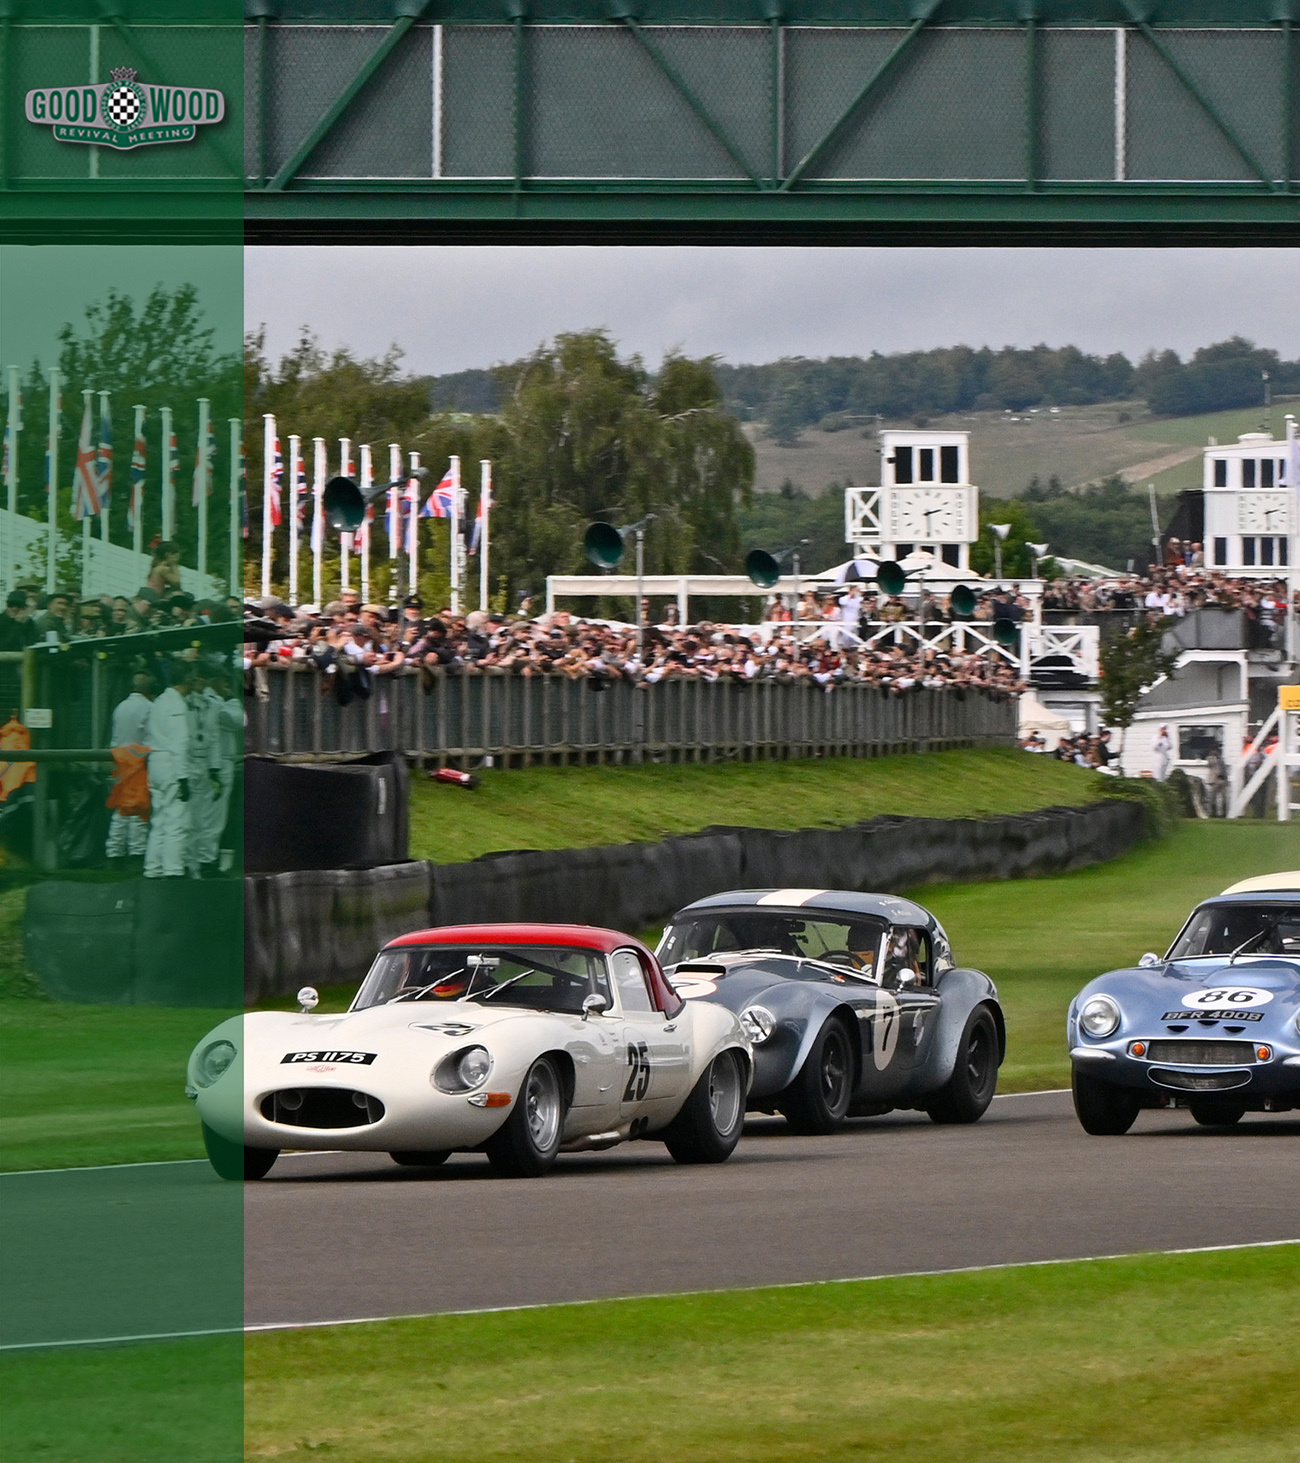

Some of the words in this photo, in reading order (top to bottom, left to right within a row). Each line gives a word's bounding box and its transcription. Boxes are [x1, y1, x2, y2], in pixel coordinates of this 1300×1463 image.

[1197, 990, 1258, 1003] 86
[1164, 1011, 1205, 1020] BFR
[882, 1006, 895, 1052] 7
[291, 1052, 320, 1062] PS
[321, 1052, 366, 1063] 1175
[622, 1041, 651, 1103] 25
